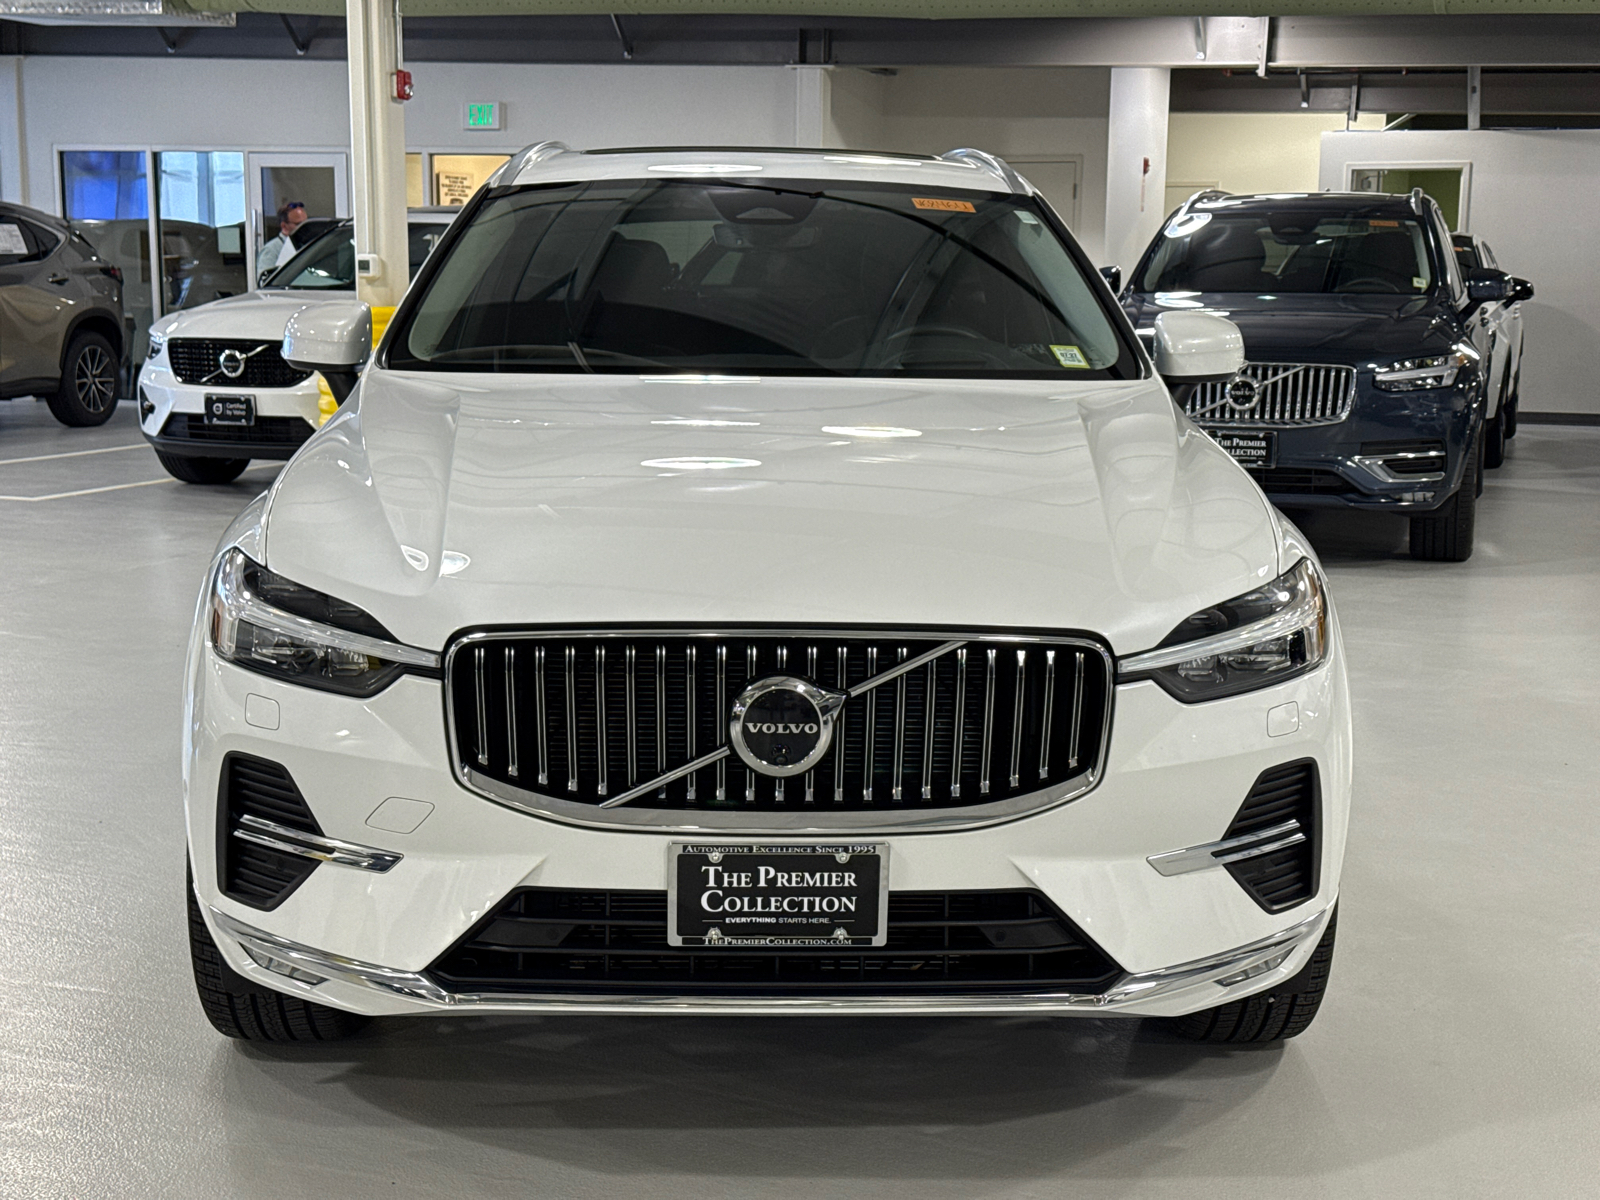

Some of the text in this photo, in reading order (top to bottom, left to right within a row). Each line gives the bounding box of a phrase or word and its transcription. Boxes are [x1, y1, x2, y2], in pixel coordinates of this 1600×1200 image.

[469, 104, 494, 126] EXIT
[1215, 438, 1267, 447] THE PREMIER
[745, 722, 818, 734] VOLVO
[685, 845, 874, 853] AUTOMOTIVE EXCELLENCE SINCE 1995
[701, 865, 858, 888] THE PREMIER
[701, 889, 858, 912] COLLECTION
